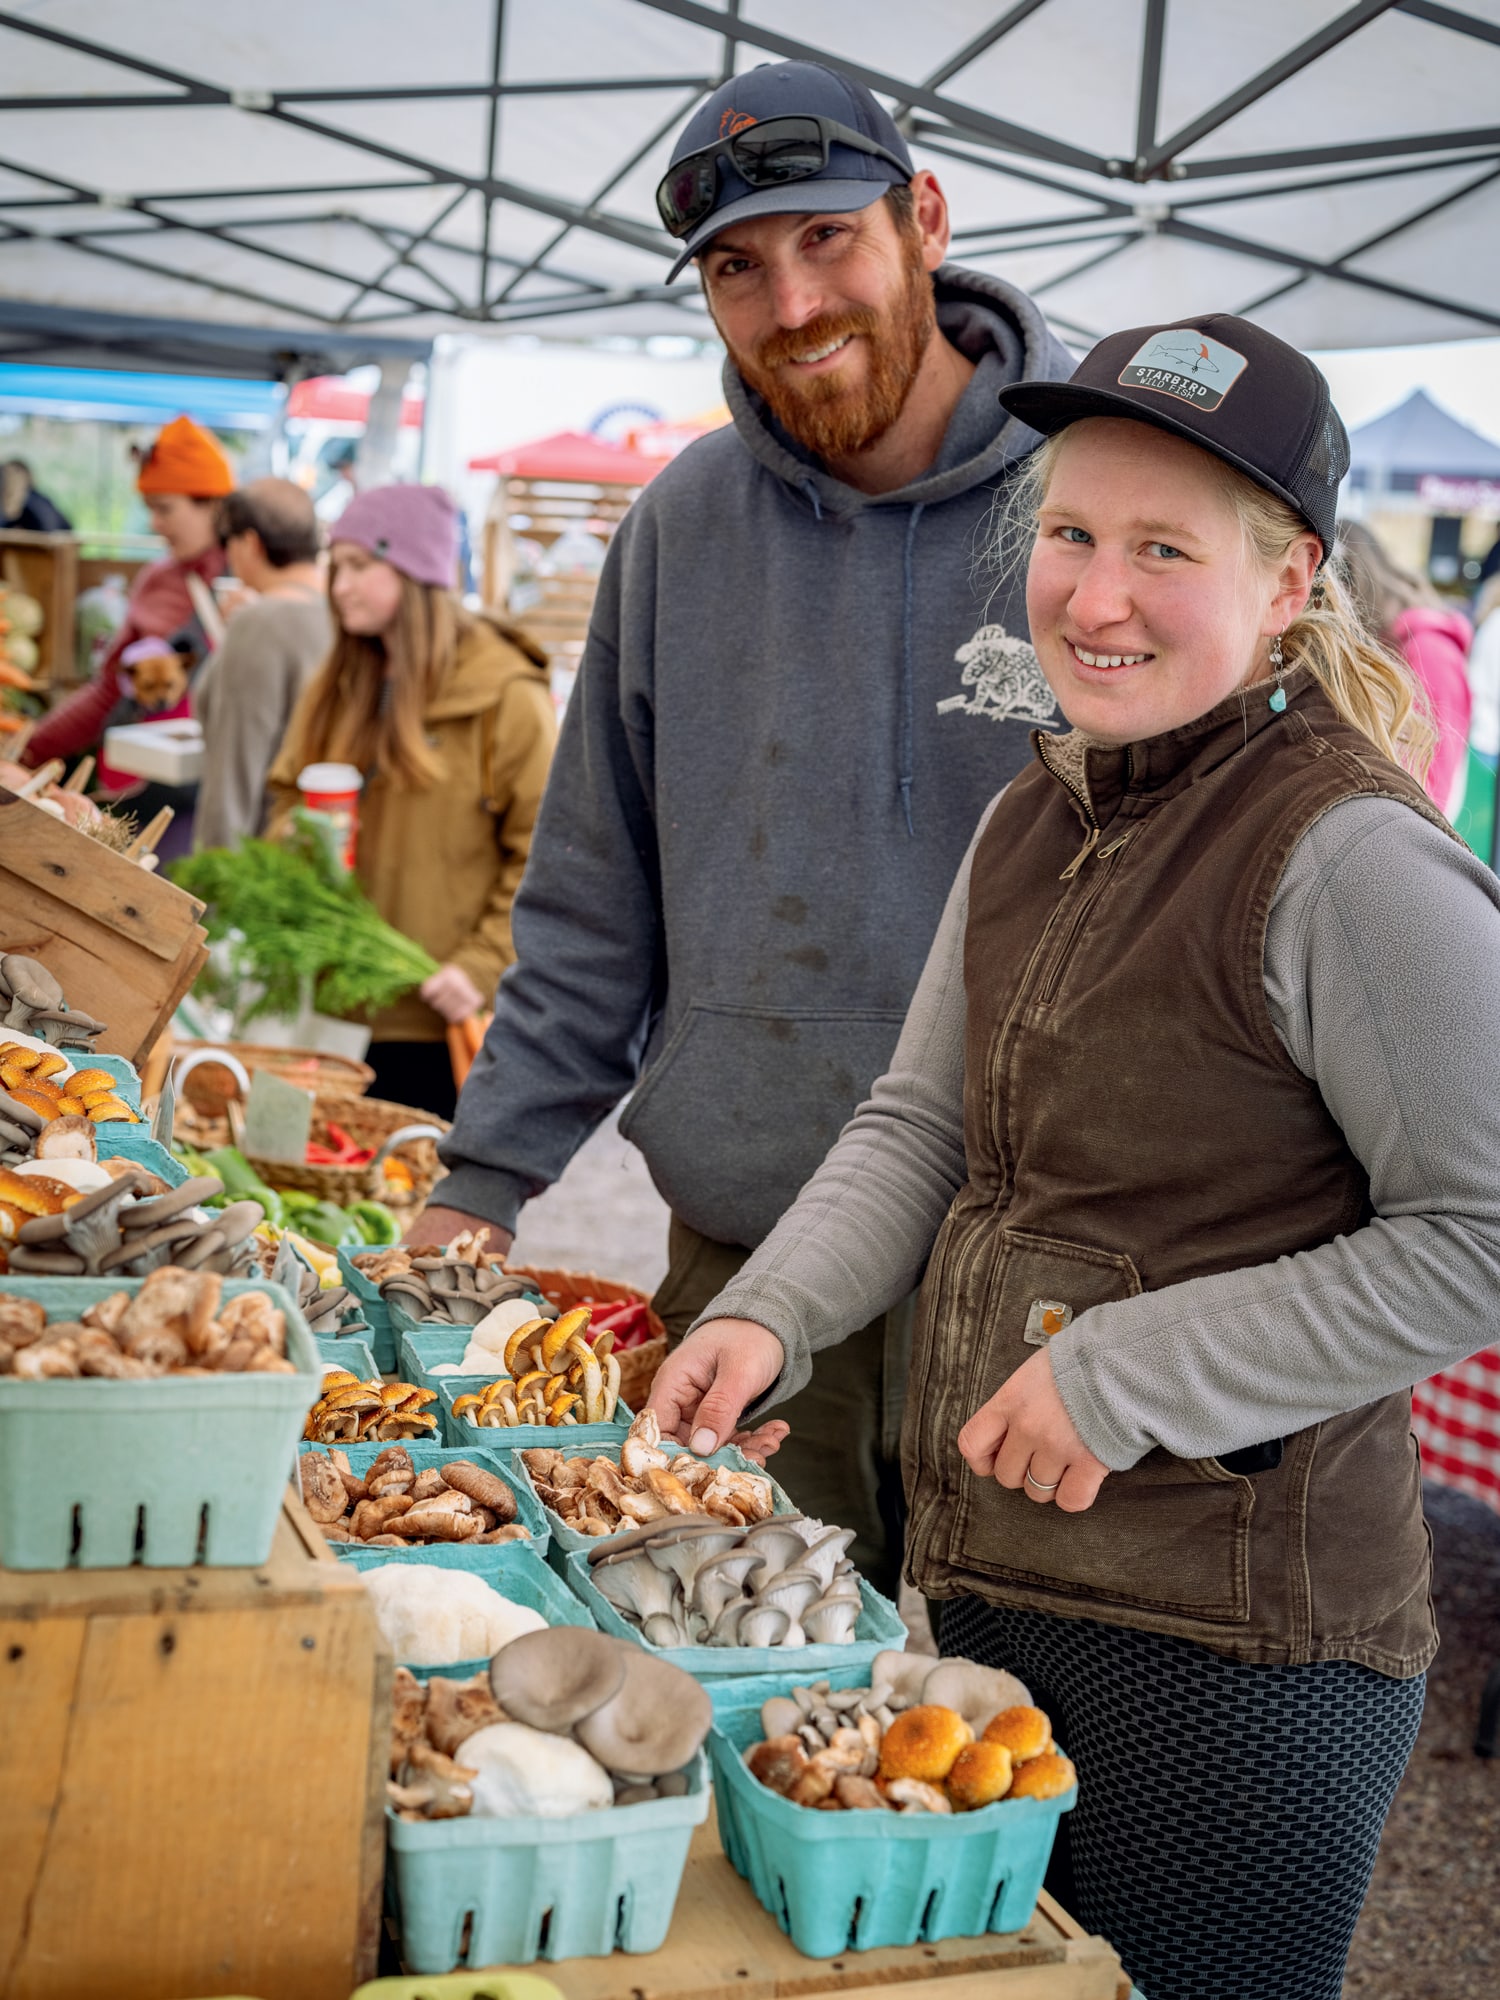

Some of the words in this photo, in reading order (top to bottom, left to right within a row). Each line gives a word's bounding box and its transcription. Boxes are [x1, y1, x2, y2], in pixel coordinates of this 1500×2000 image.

[1136, 367, 1207, 396] STARBIRD
[1140, 377, 1165, 388] WILD
[1168, 384, 1196, 400] FISH
